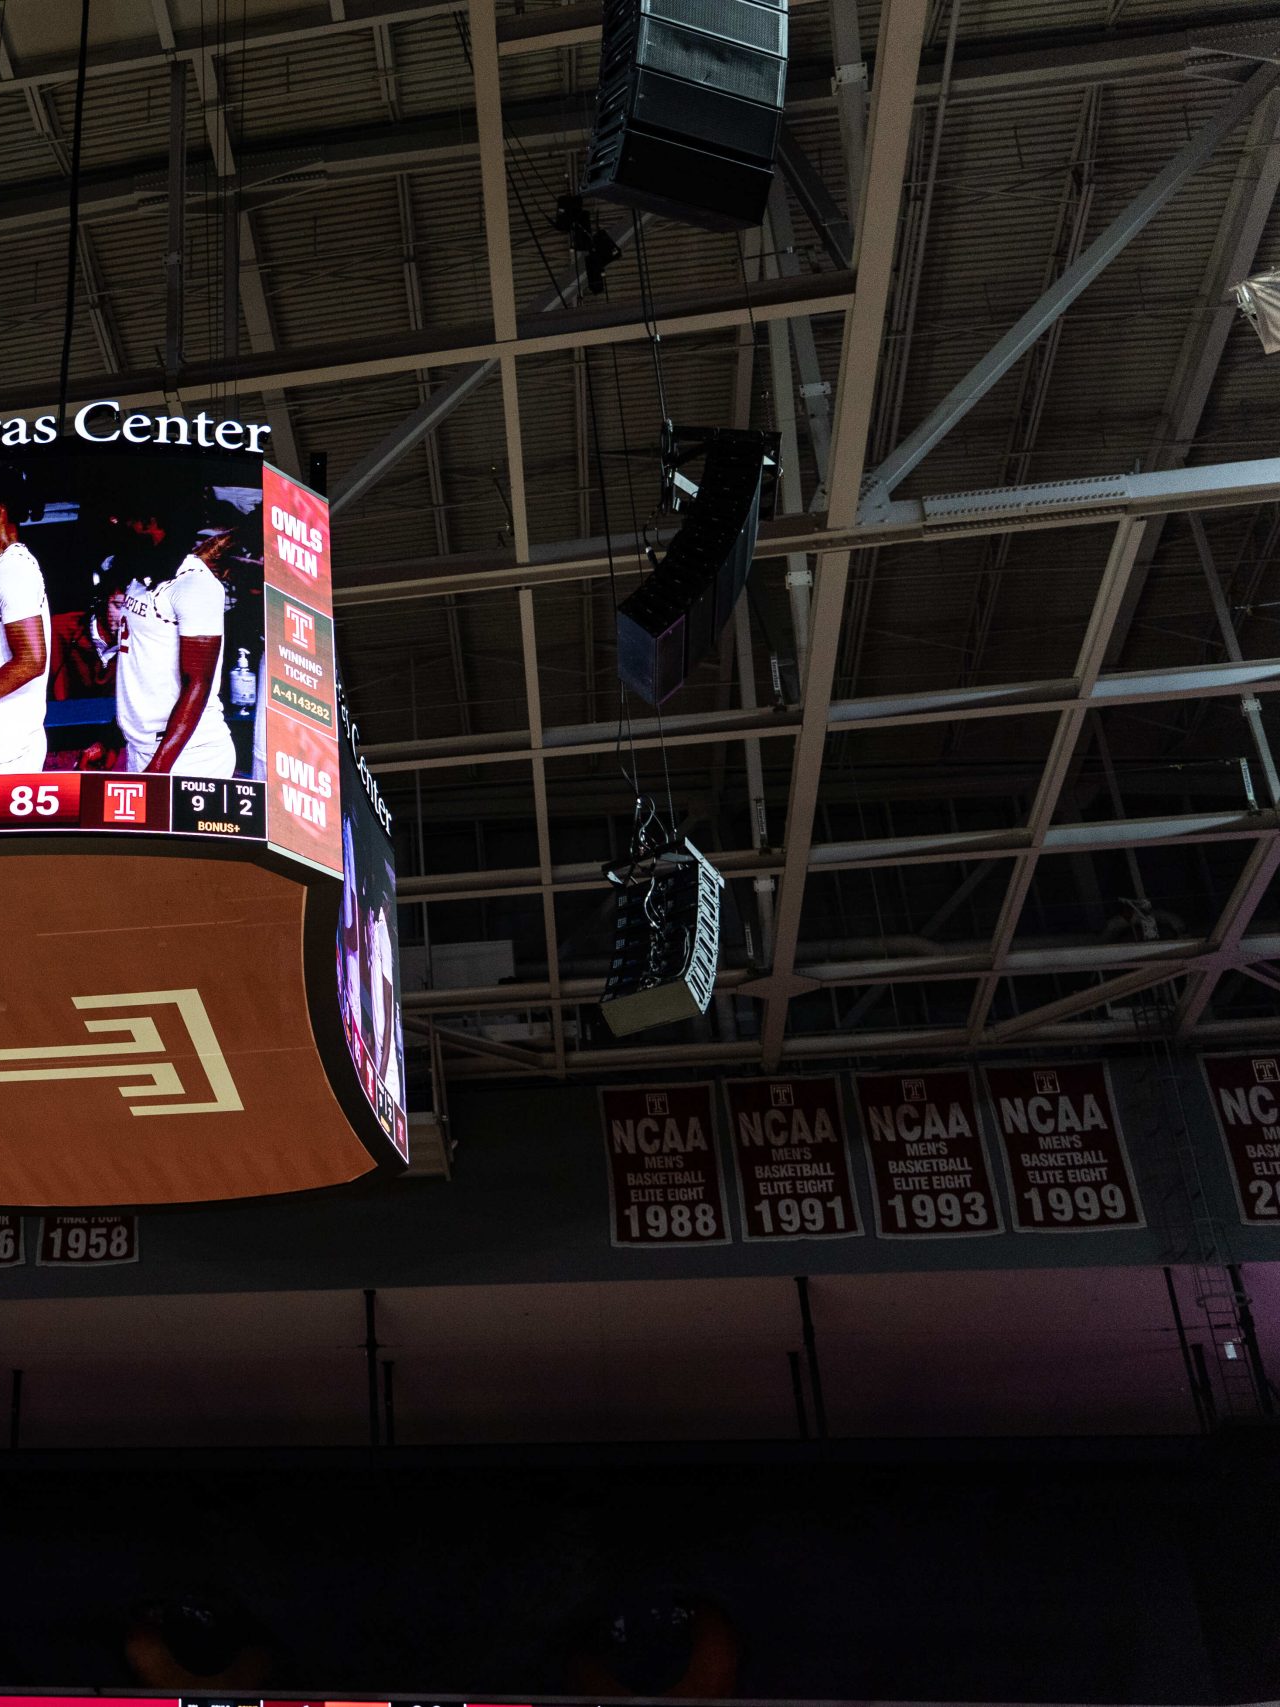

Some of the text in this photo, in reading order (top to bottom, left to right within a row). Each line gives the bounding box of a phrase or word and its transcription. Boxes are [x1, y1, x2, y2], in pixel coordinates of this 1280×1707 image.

[74, 402, 271, 453] Center
[271, 506, 322, 553] OWLS
[277, 536, 317, 578] WIN
[278, 645, 322, 677] WINNING
[284, 663, 318, 690] TICKET
[273, 683, 330, 720] A-4143282
[181, 781, 215, 793] FOULS
[275, 750, 331, 797] OWLS
[9, 785, 59, 816] 85
[191, 795, 205, 812] 9
[235, 785, 256, 796] TOL
[282, 783, 326, 828] WIN
[240, 800, 253, 816] 2
[198, 821, 240, 833] BONUS+
[999, 1093, 1108, 1135] NCAA
[1219, 1085, 1279, 1125] NC
[610, 1117, 708, 1154] NCAA
[737, 1107, 838, 1147] NCAA
[868, 1101, 972, 1142] NCAA
[771, 1147, 812, 1161] MEN'S
[905, 1141, 948, 1157] MEN'S
[1038, 1134, 1082, 1150] MEN'S
[644, 1155, 684, 1169] MEN'S
[754, 1162, 835, 1179] BASKETBALL
[888, 1156, 973, 1174] BASKETBALL
[1021, 1150, 1108, 1168] BASKETBALL
[626, 1170, 705, 1186] BASKETBALL
[758, 1178, 834, 1196] ELITE EIGHT
[893, 1173, 972, 1191] ELITE EIGHT
[1027, 1167, 1108, 1185] ELITE EIGHT
[629, 1186, 704, 1203] ELITE EIGHT
[887, 1191, 988, 1229] 1993
[1024, 1184, 1126, 1222] 1999
[1248, 1179, 1280, 1215] 2
[624, 1203, 717, 1238] 1988
[754, 1195, 846, 1234] 1991
[48, 1225, 128, 1259] 1958
